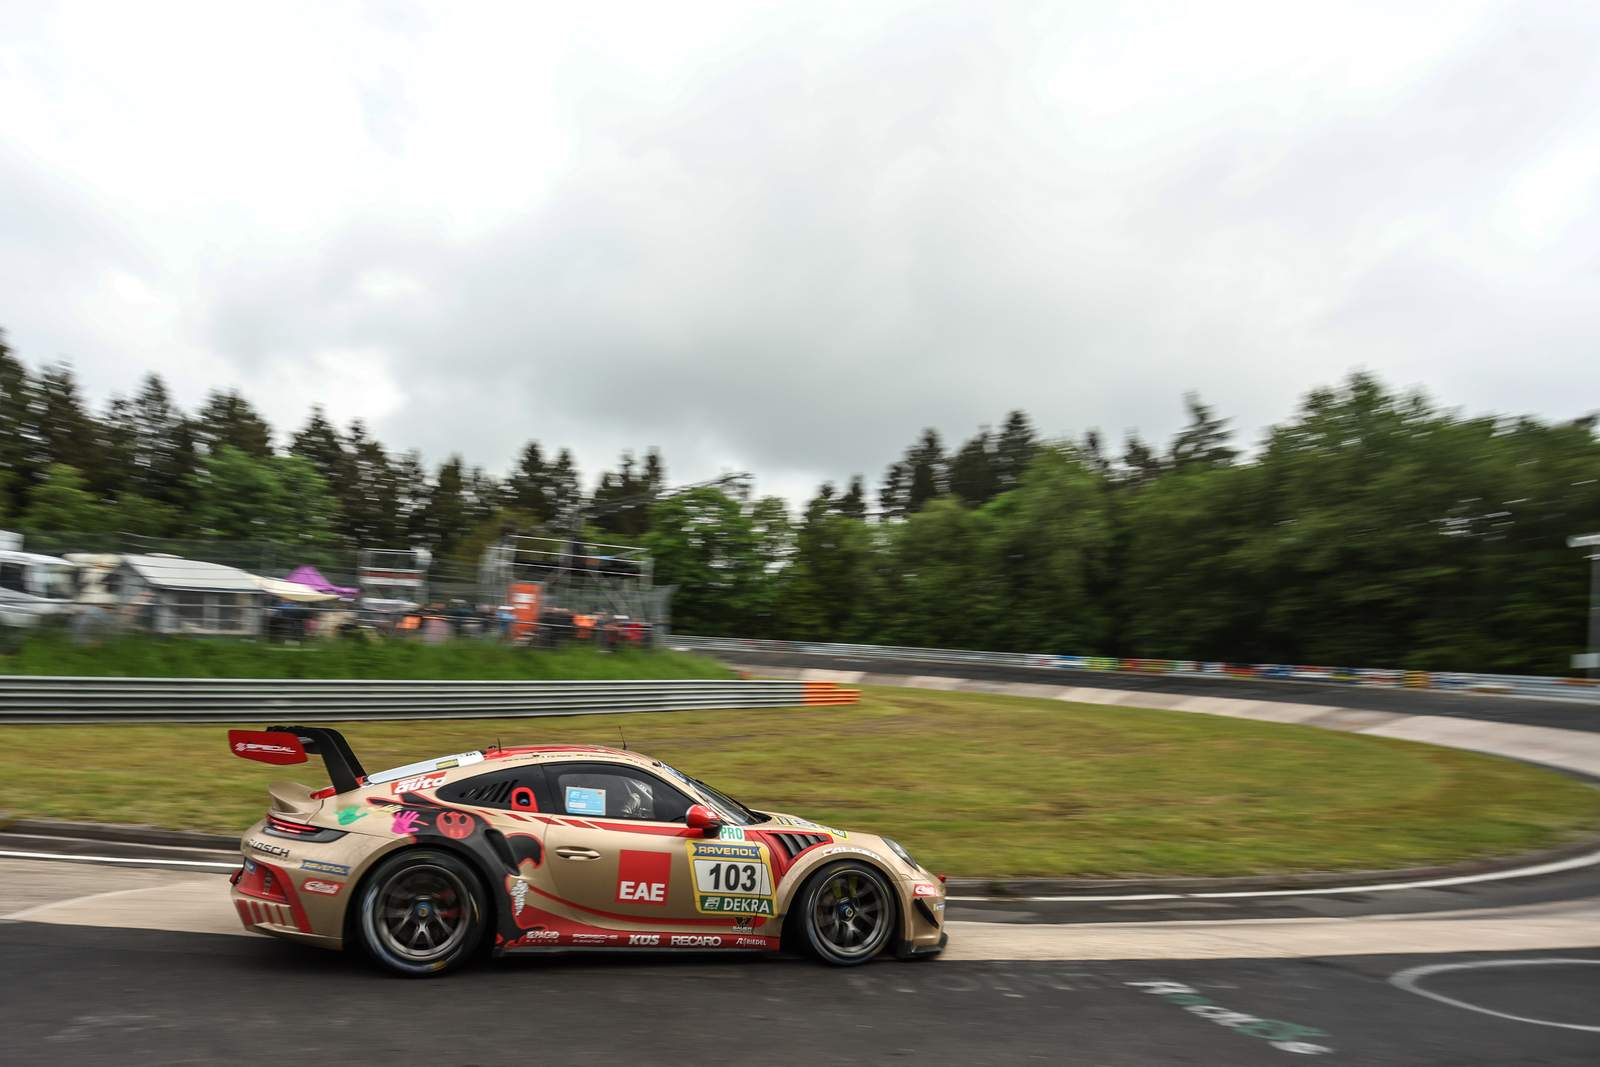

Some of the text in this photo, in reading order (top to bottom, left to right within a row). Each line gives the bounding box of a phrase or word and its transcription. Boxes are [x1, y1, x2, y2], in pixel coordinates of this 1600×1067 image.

[395, 776, 447, 794] auto
[721, 827, 743, 840] PRO
[698, 846, 756, 857] RAVENOL
[708, 863, 757, 892] 103
[619, 880, 666, 902] EAE
[723, 897, 770, 914] DEKRA
[670, 935, 722, 946] RECARO
